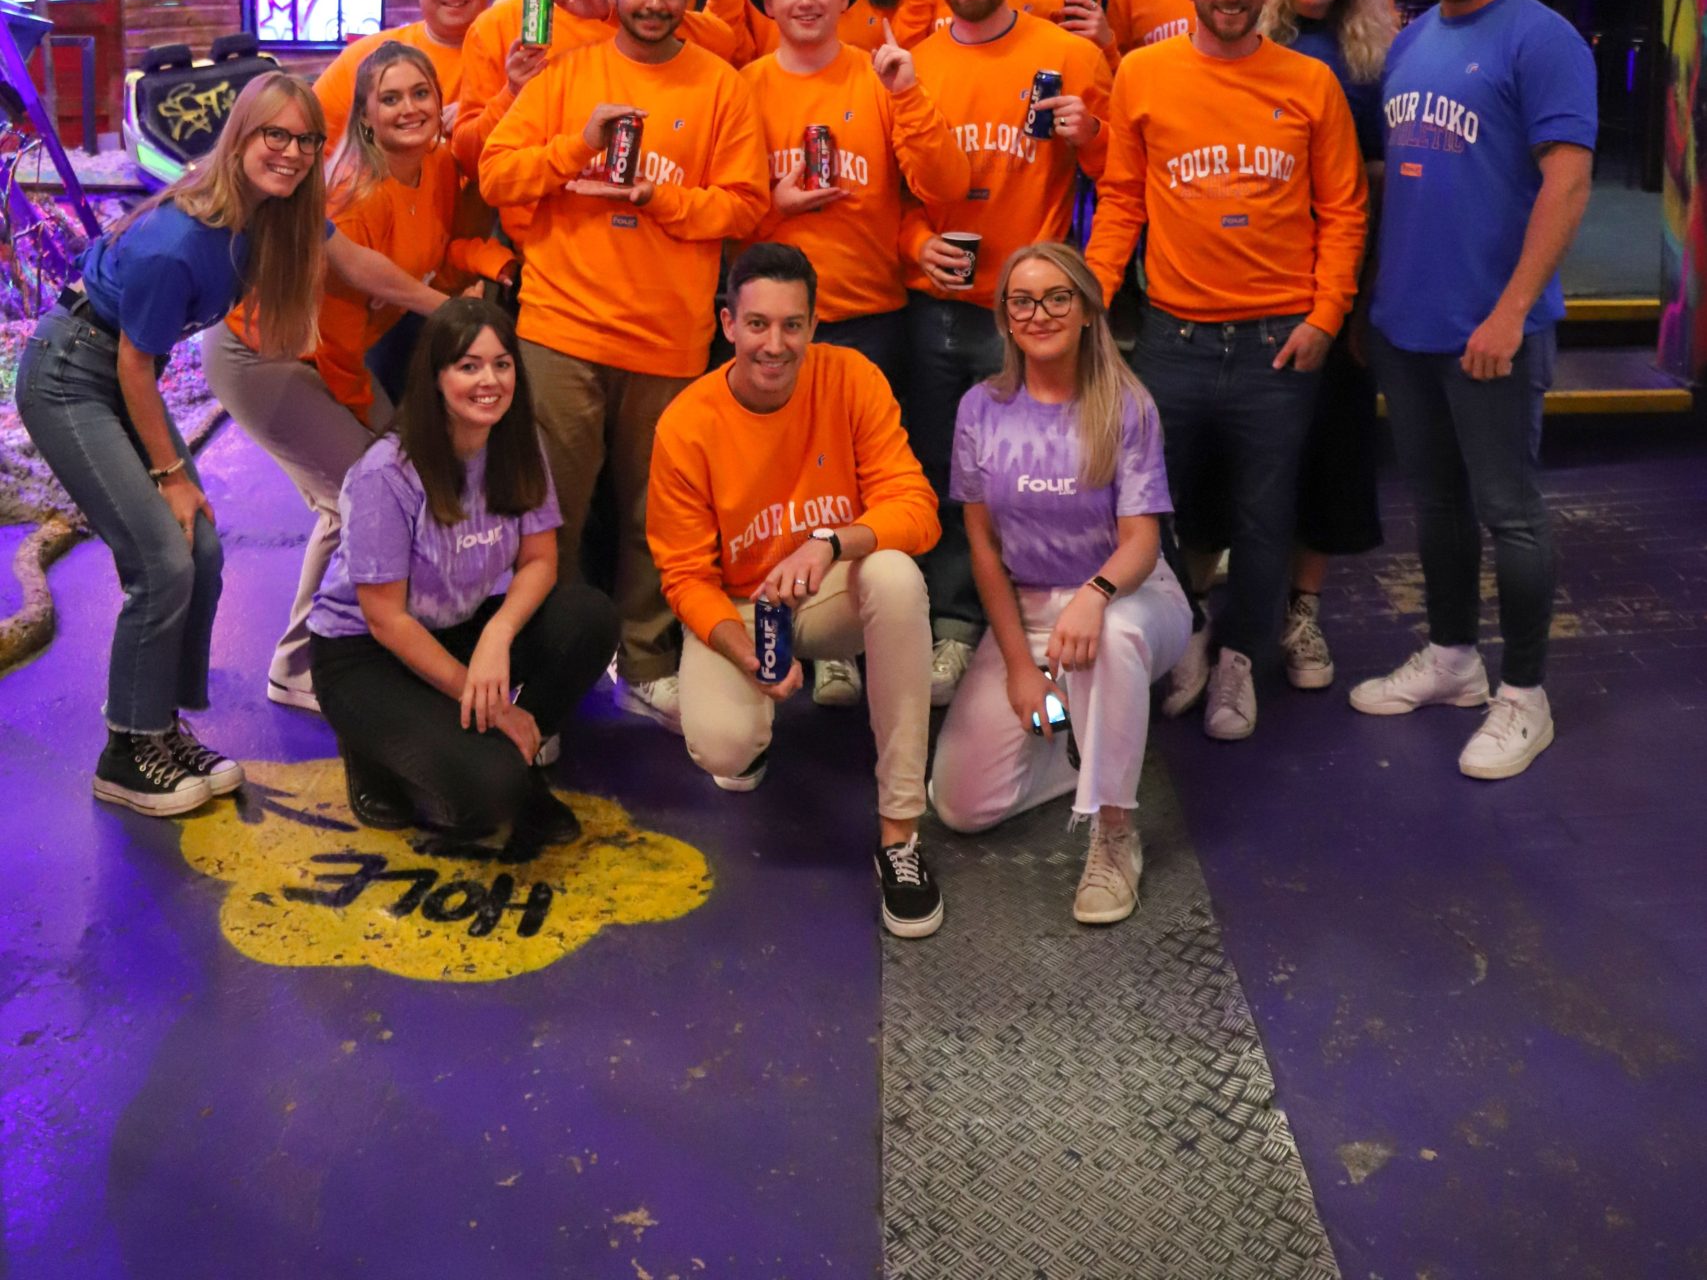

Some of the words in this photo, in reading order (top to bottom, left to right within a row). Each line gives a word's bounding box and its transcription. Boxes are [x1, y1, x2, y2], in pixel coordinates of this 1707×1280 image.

[1422, 91, 1479, 144] LOKO
[1167, 144, 1230, 189] FOUR
[1237, 143, 1295, 182] LOKO
[1017, 474, 1077, 493] four
[729, 503, 784, 564] FOUR
[788, 495, 854, 534] LOKO
[761, 618, 777, 680] four
[282, 852, 554, 938] HOLE
